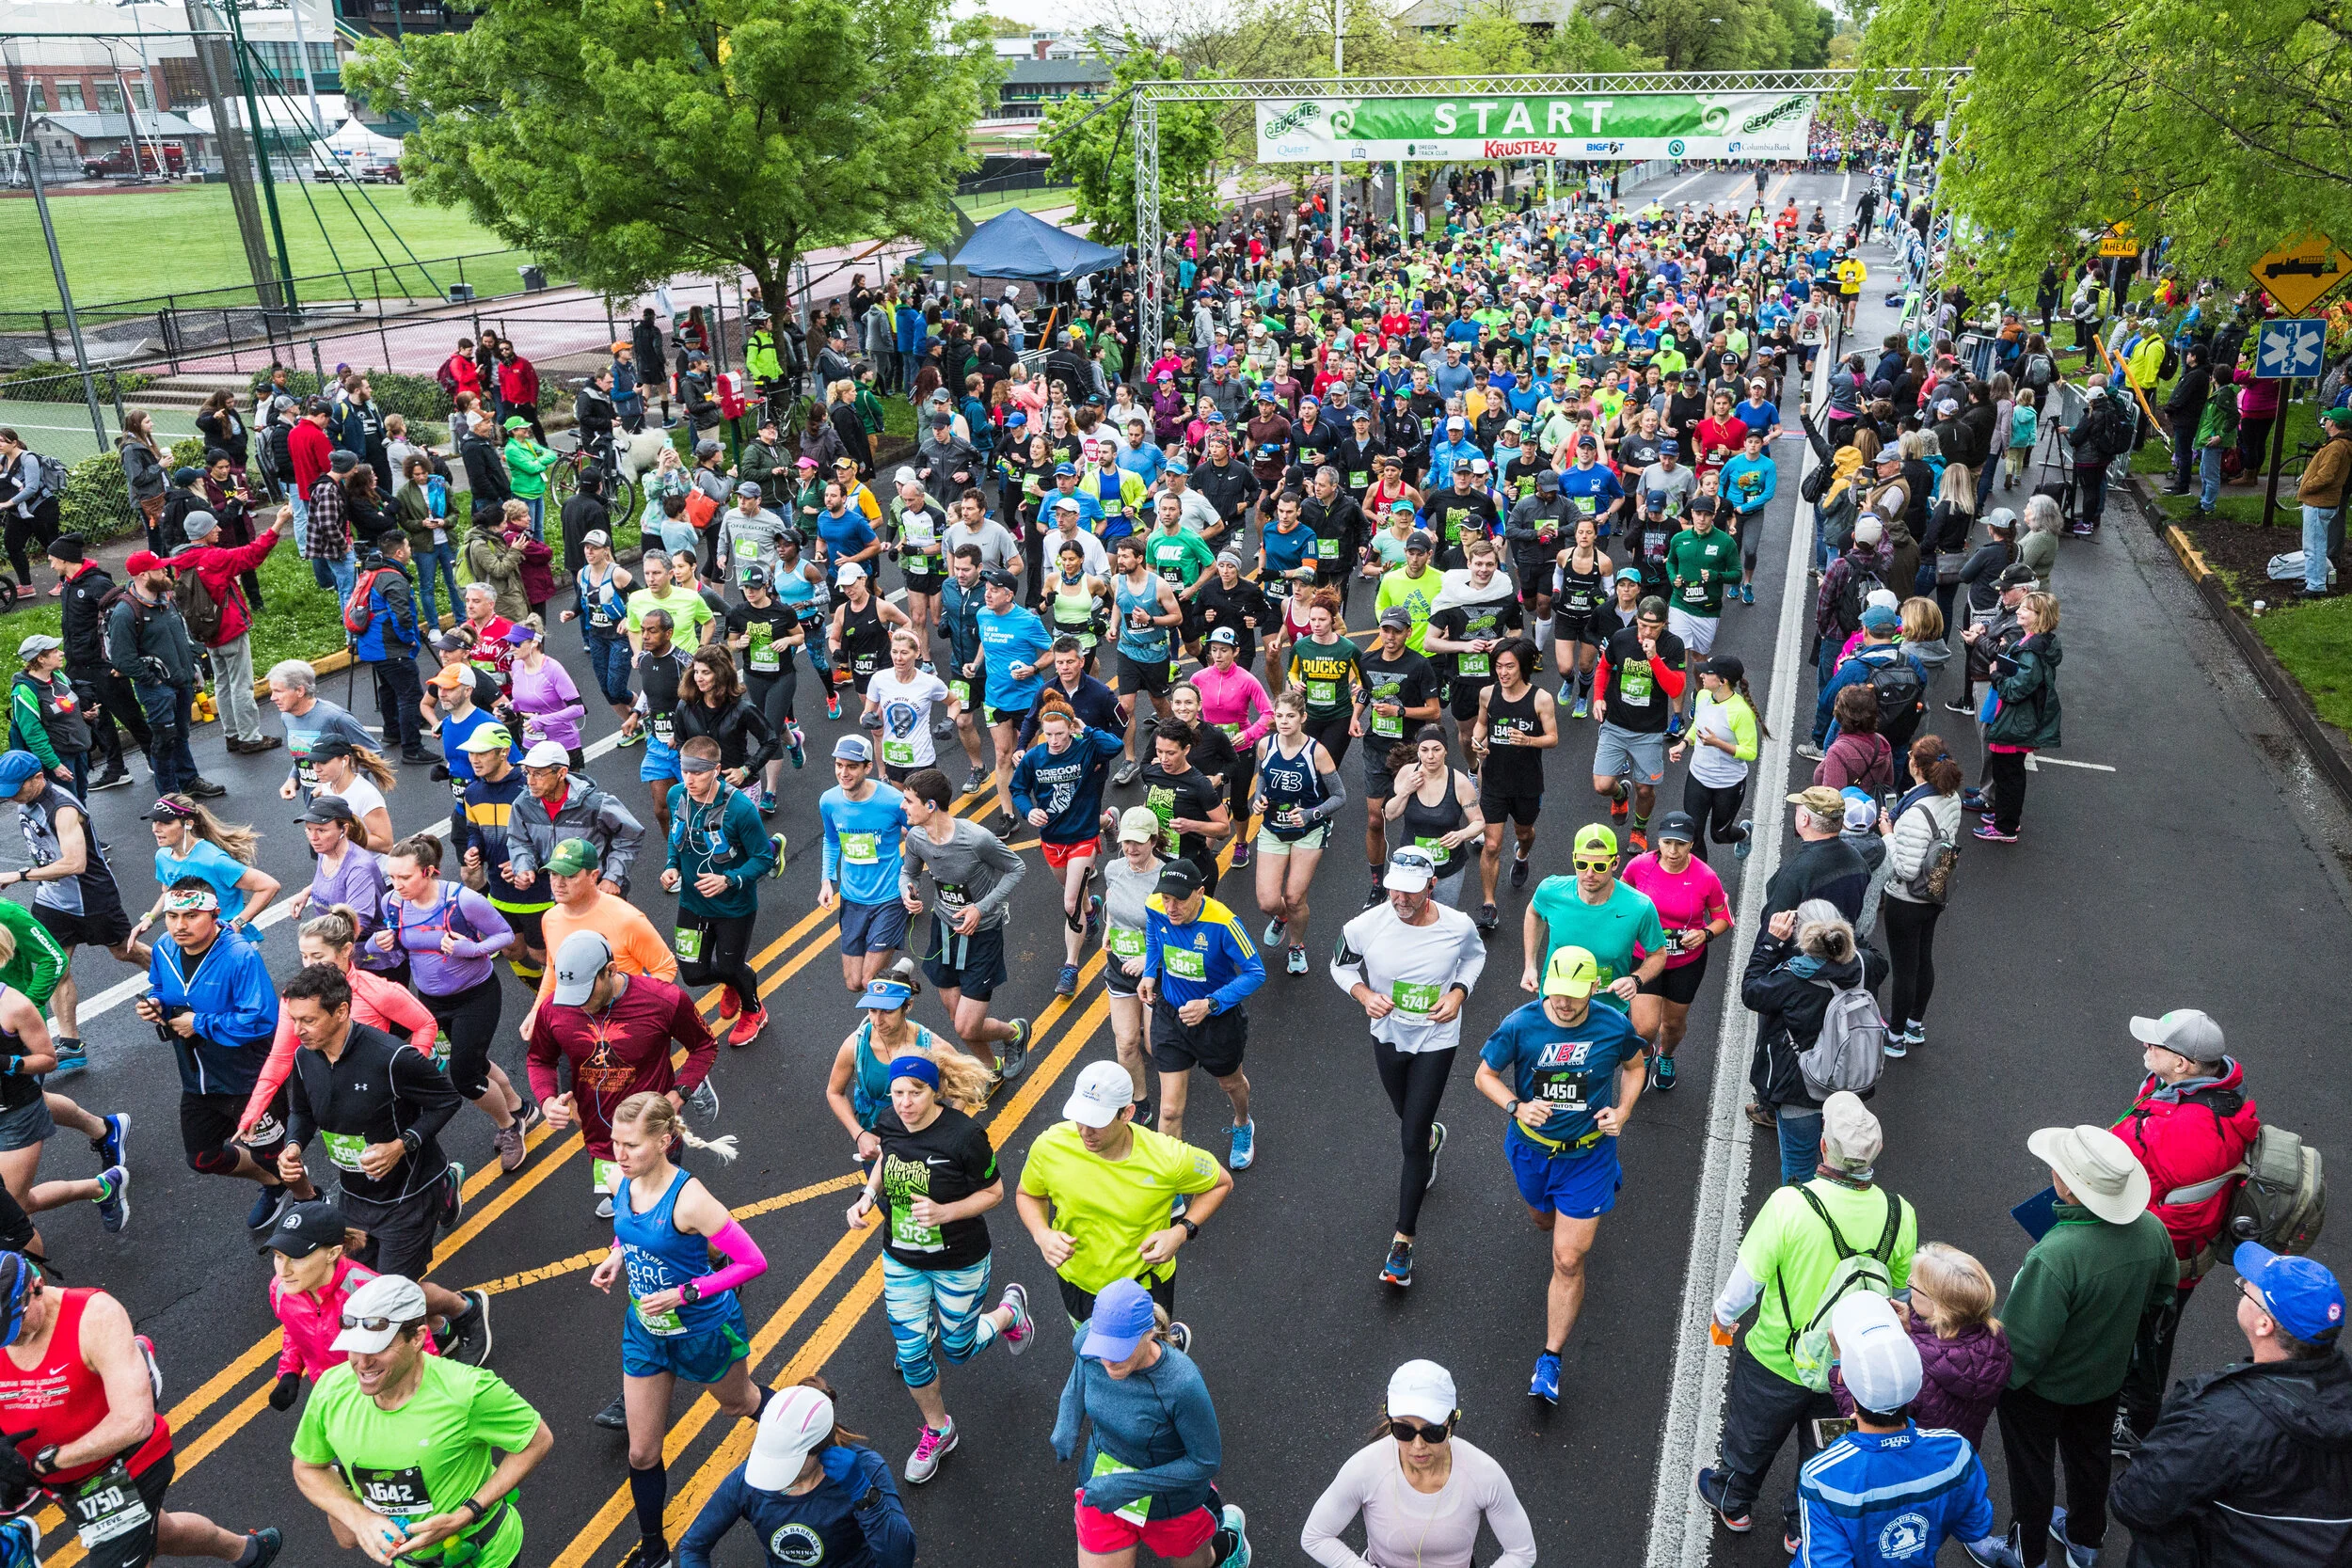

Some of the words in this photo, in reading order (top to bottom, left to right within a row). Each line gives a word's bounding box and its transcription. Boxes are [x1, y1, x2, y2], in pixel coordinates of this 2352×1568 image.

[1274, 104, 1314, 134] EUGENE
[1434, 101, 1613, 135] START
[1754, 98, 1804, 128] EUGENE
[1484, 140, 1558, 159] KRUSTEAZ
[1741, 142, 1773, 151] Columbia
[2103, 243, 2134, 252] AHEAD
[1156, 546, 1184, 561] NIKE
[1685, 587, 1705, 596] 2008
[1570, 595, 1588, 606] 1900
[854, 659, 873, 670] 2047
[1302, 658, 1347, 674] DUCKS
[1464, 660, 1485, 672] 3434
[654, 719, 674, 731] 2074
[1375, 718, 1396, 731] 3310
[1035, 763, 1081, 777] OREGON
[1166, 870, 1188, 880] FORTIVE
[940, 889, 965, 904] 1694
[1168, 957, 1198, 975] 5842
[1400, 993, 1430, 1010] 5741
[1539, 1041, 1593, 1065] NBB
[1566, 1058, 1585, 1067] CLUB
[1542, 1083, 1577, 1100] 1450
[886, 1154, 930, 1175] EUGENE
[899, 1223, 931, 1243] 5725
[365, 1482, 415, 1502] 1642
[77, 1486, 125, 1520] 1750
[96, 1515, 122, 1531] STEVE
[789, 1526, 820, 1550] BARBARA
